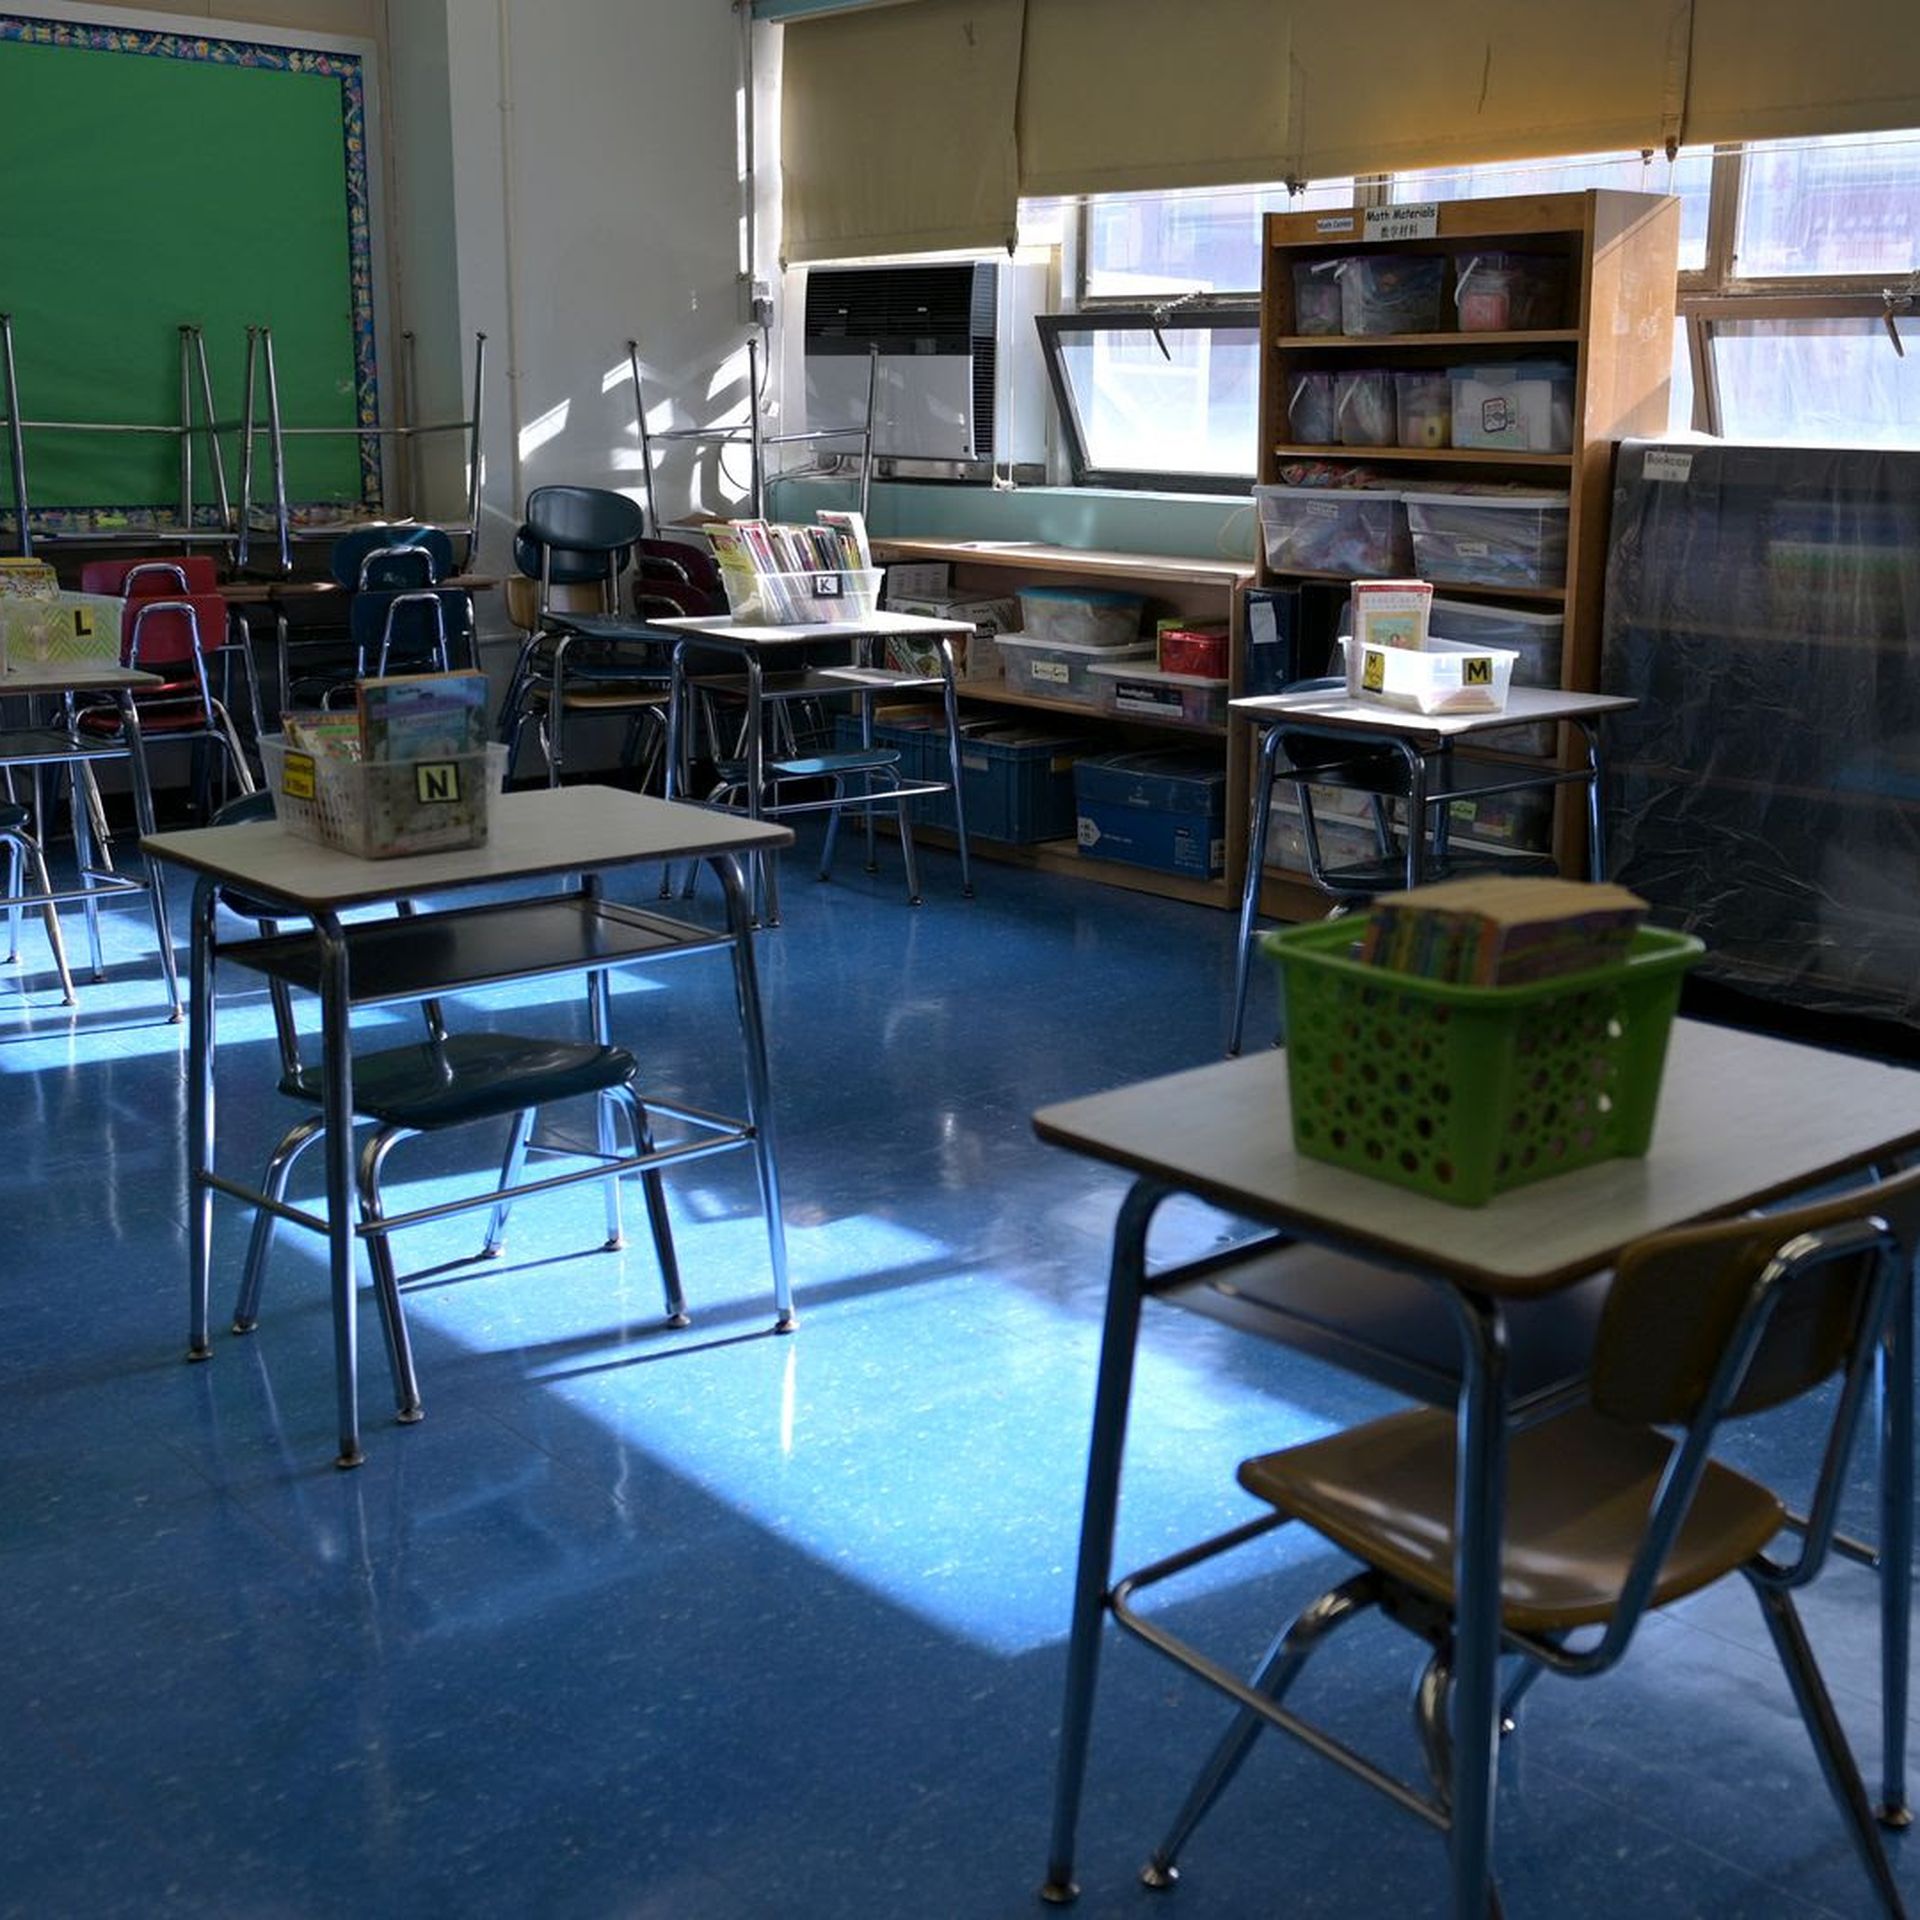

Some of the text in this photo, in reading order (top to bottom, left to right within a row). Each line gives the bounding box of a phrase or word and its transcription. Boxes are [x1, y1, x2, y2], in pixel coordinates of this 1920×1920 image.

[1366, 205, 1436, 222] Math Materials
[819, 578, 831, 592] K
[74, 609, 92, 637] L
[1468, 660, 1488, 682] M
[425, 768, 449, 799] N
